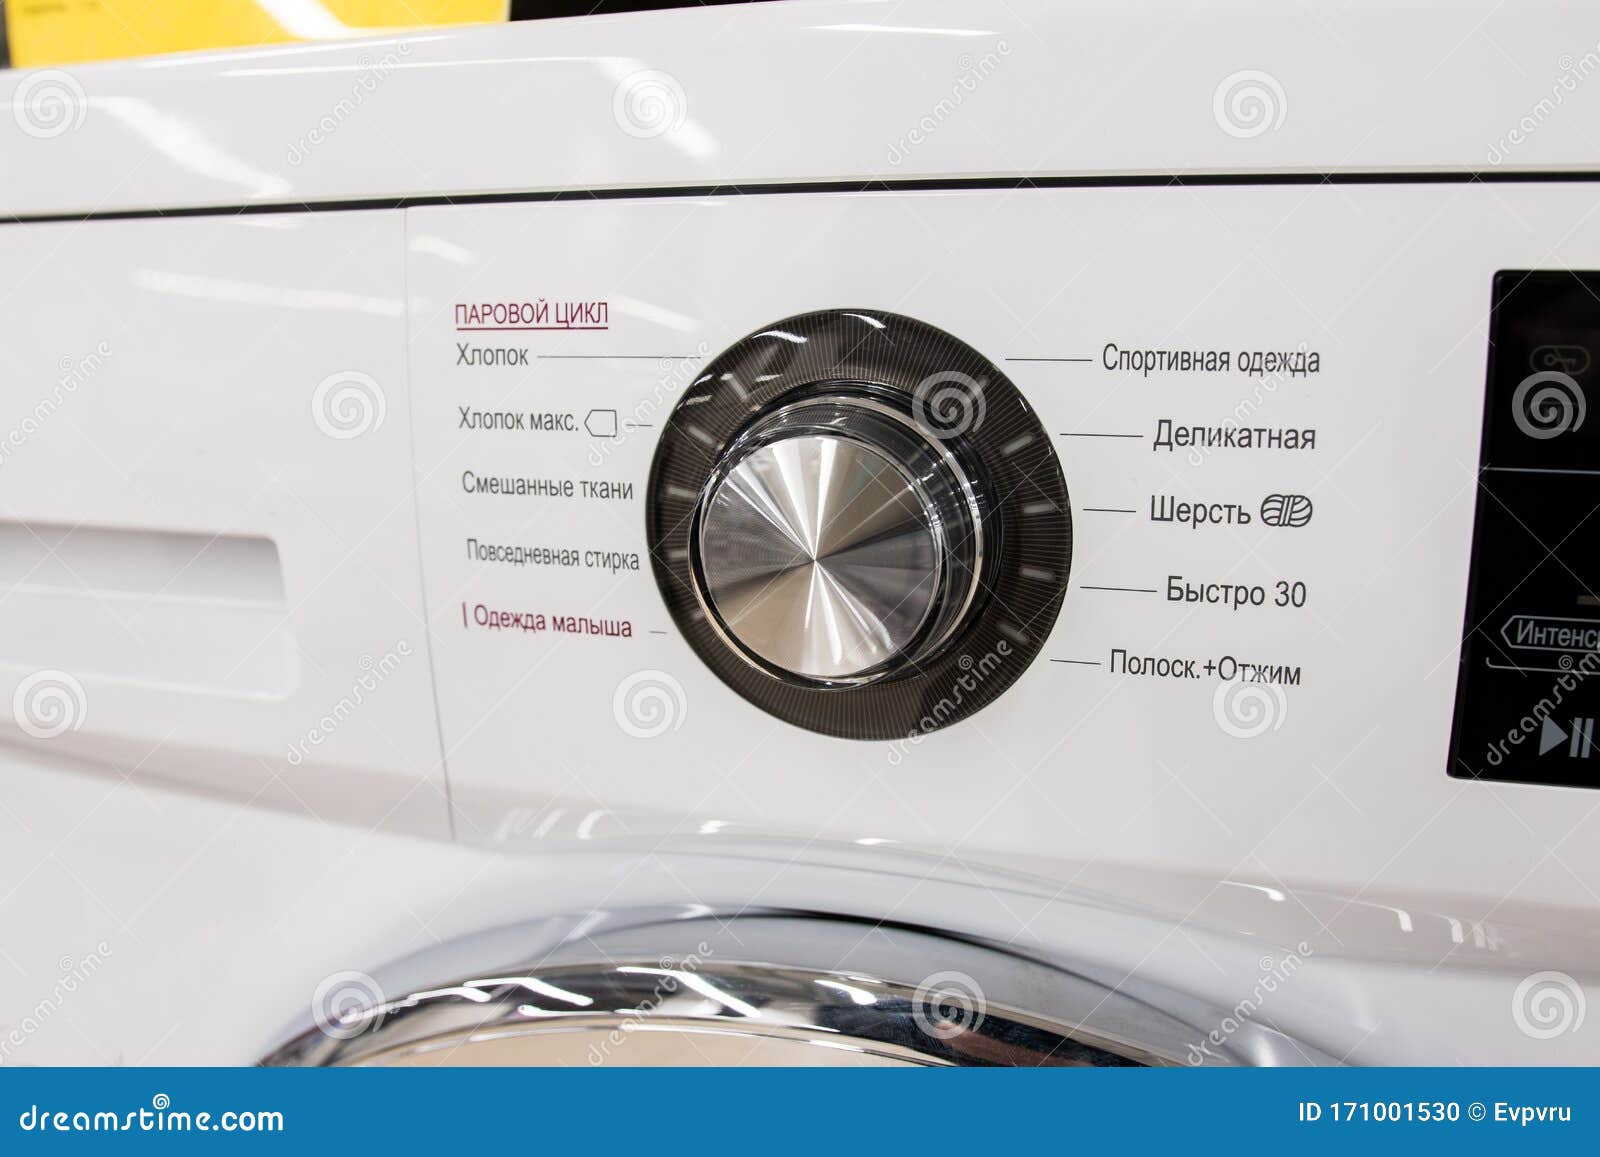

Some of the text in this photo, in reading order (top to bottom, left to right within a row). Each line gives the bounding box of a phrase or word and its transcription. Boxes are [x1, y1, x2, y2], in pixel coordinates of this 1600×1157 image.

[455, 298, 608, 328] ПАРОВОЙ ЦИКЛ
[456, 342, 529, 366] Хлопок
[1102, 342, 1321, 378] Спортивная одежда
[458, 406, 579, 432] Хлопок макс.
[1153, 419, 1316, 452] Деликатная
[462, 470, 633, 499] Смешанные ткани
[1150, 495, 1252, 530] Шерсть
[466, 538, 640, 575] Повседневная стирка
[1166, 575, 1307, 611] Быстро 30
[473, 604, 633, 638] Одежда малыша
[1516, 619, 1600, 650] Интенс
[1109, 648, 1302, 685] Полоск.+Отжим
